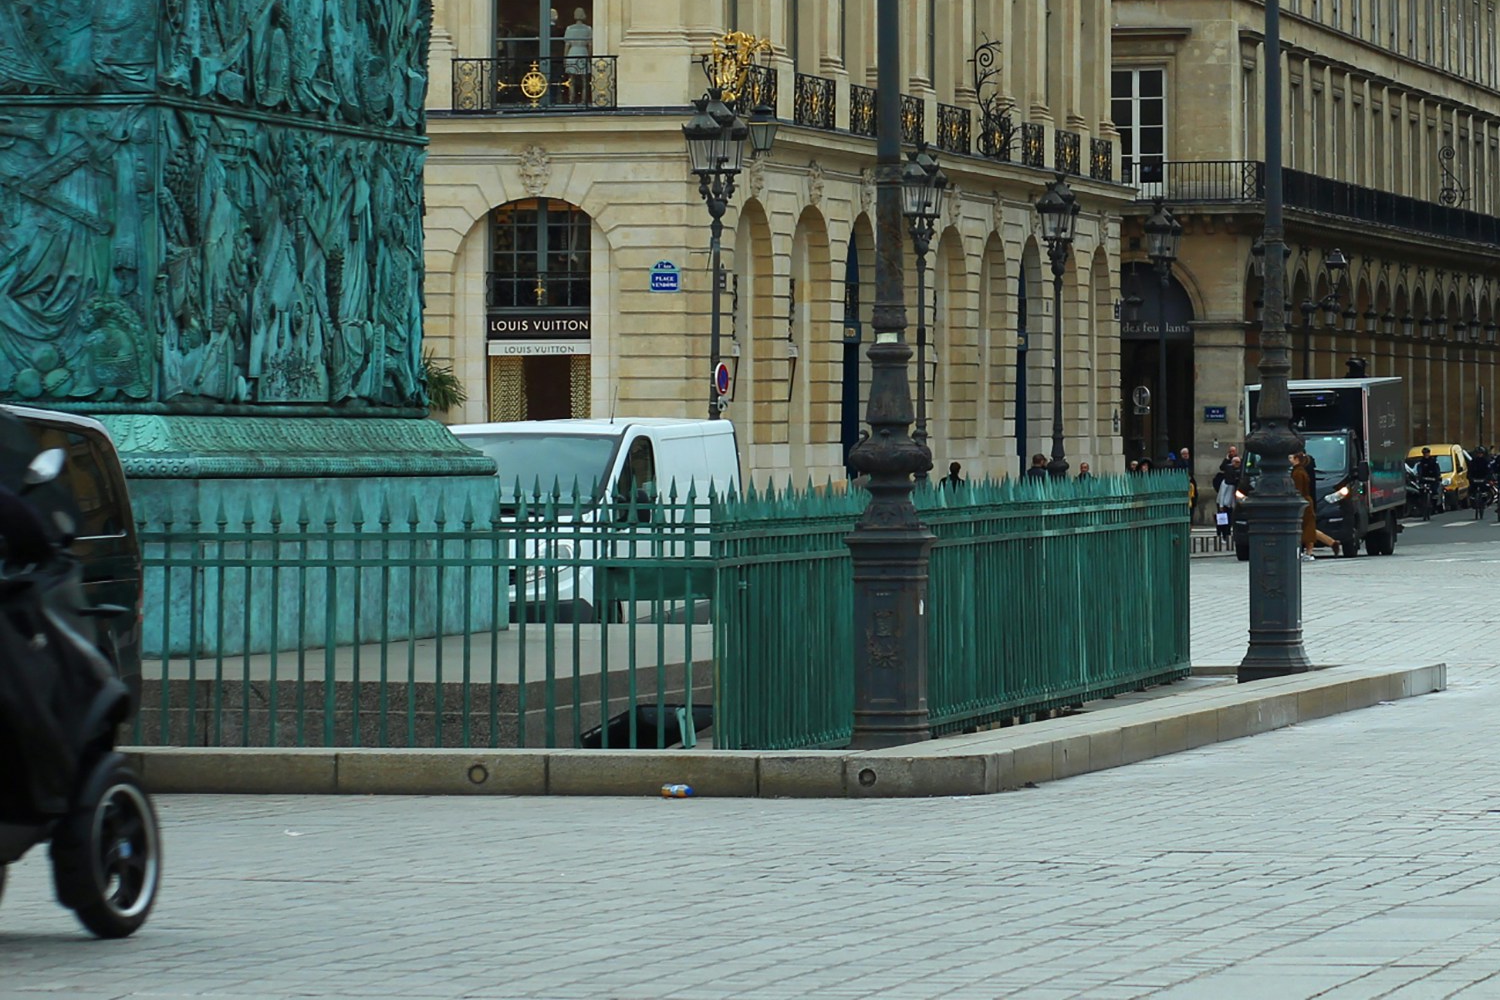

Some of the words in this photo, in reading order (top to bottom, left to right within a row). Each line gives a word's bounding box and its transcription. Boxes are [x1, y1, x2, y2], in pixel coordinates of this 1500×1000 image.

[491, 320, 529, 331] LOUIS
[533, 320, 589, 331] VUITTON
[1142, 321, 1191, 333] feulants
[504, 345, 532, 354] LOUIS
[534, 345, 575, 353] VUITTON
